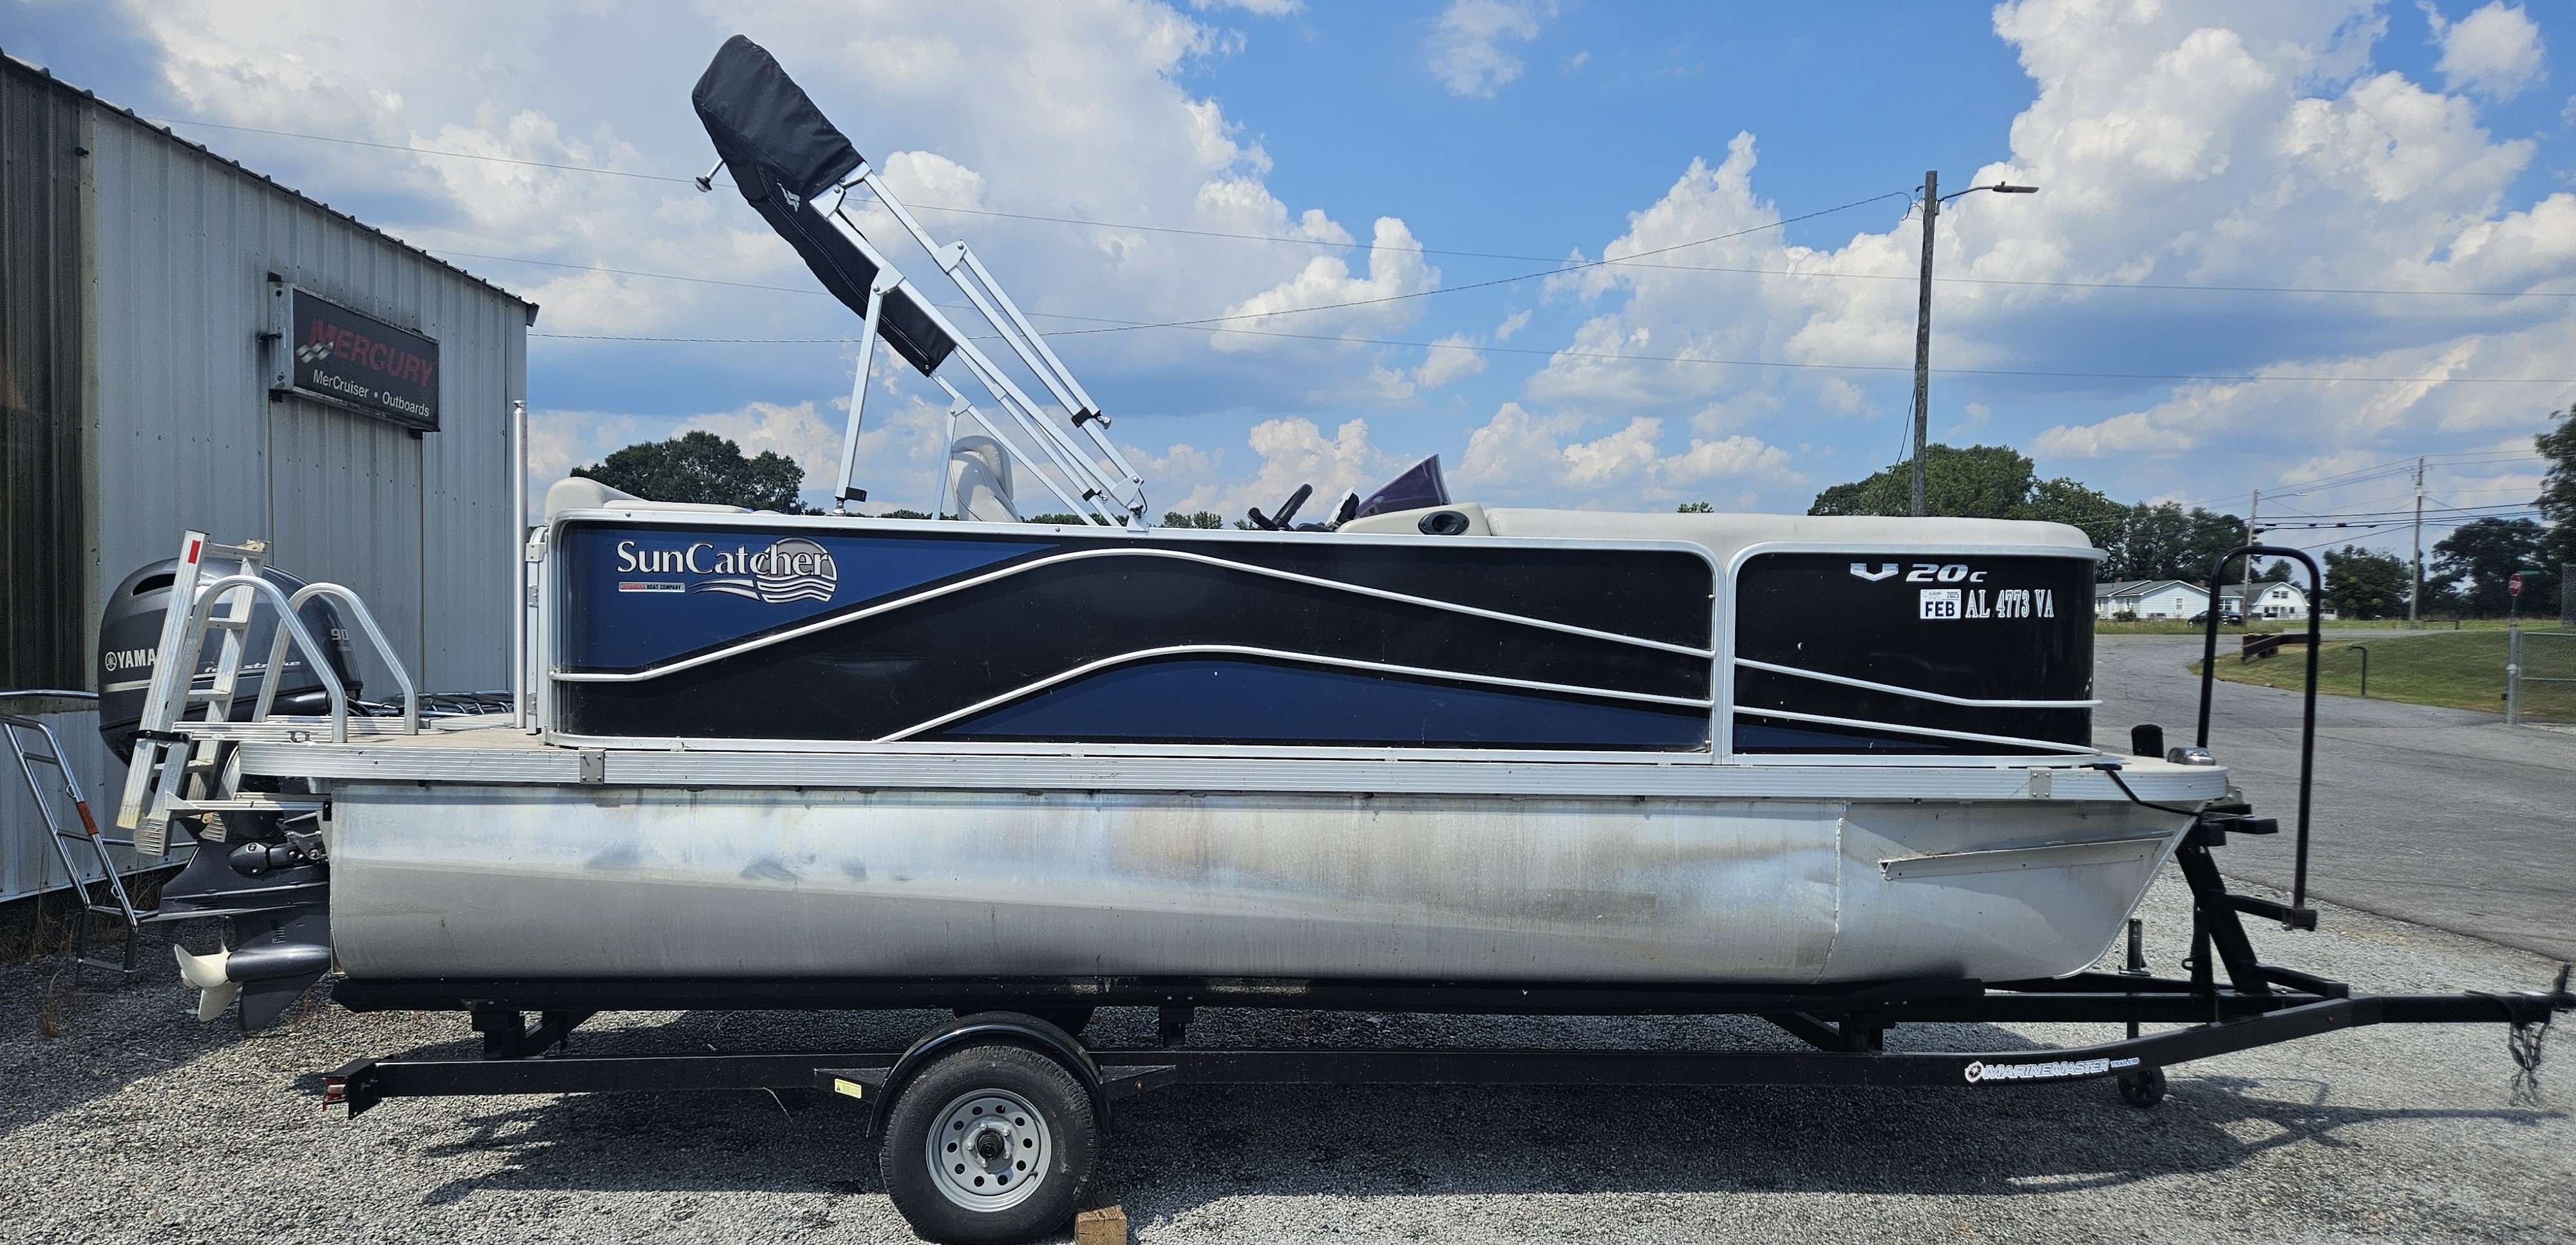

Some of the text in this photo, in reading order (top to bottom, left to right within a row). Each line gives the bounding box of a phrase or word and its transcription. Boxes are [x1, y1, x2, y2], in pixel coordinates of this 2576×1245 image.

[308, 319, 437, 386] MERCURY
[313, 369, 430, 417] MerCruiser Outboards
[617, 539, 829, 576] SunCatcher
[1925, 601, 1955, 617] FEB
[1965, 589, 2054, 618] AL 4773 VA
[330, 628, 349, 641] 90
[117, 648, 157, 669] YAMA
[1982, 1058, 2109, 1080] MARINEMASTER
